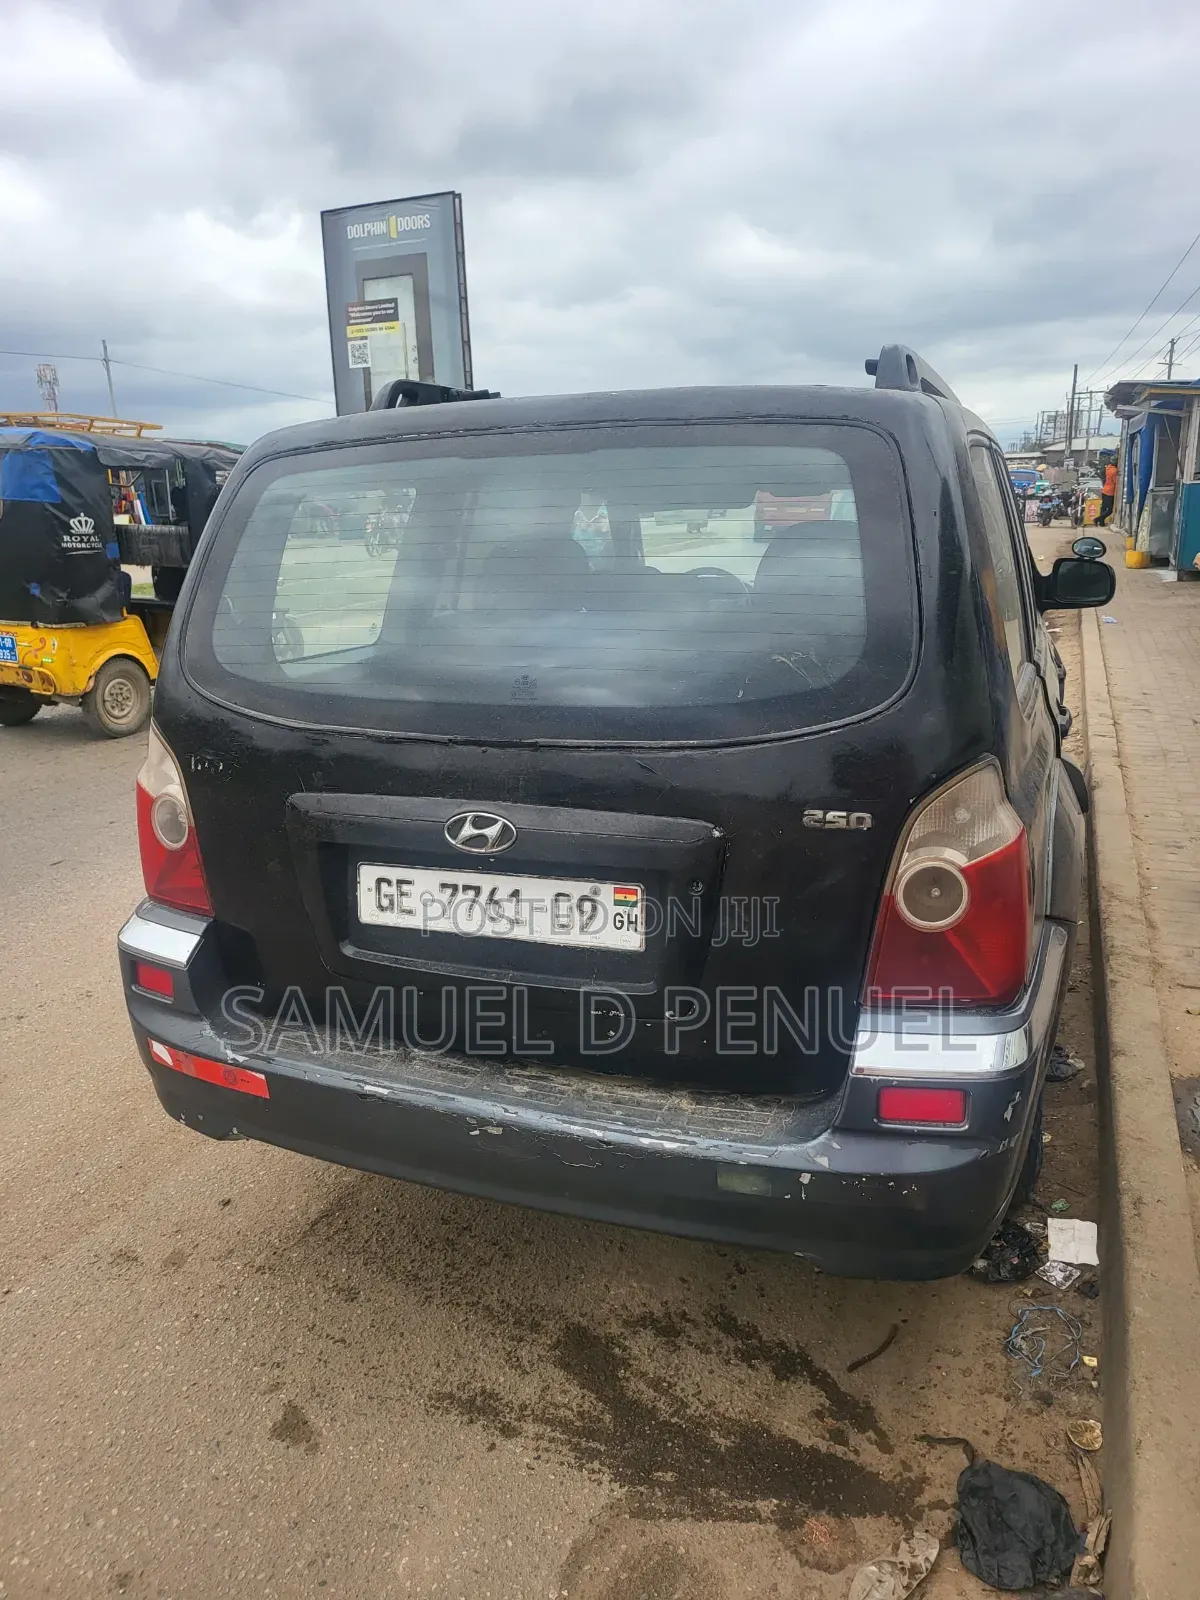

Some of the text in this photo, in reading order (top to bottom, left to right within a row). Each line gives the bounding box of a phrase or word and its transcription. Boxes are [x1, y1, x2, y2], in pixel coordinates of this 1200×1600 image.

[347, 214, 430, 239] DOLPHIN DOORS
[802, 809, 872, 829] 250
[374, 877, 416, 915] GE
[613, 912, 638, 933] GH
